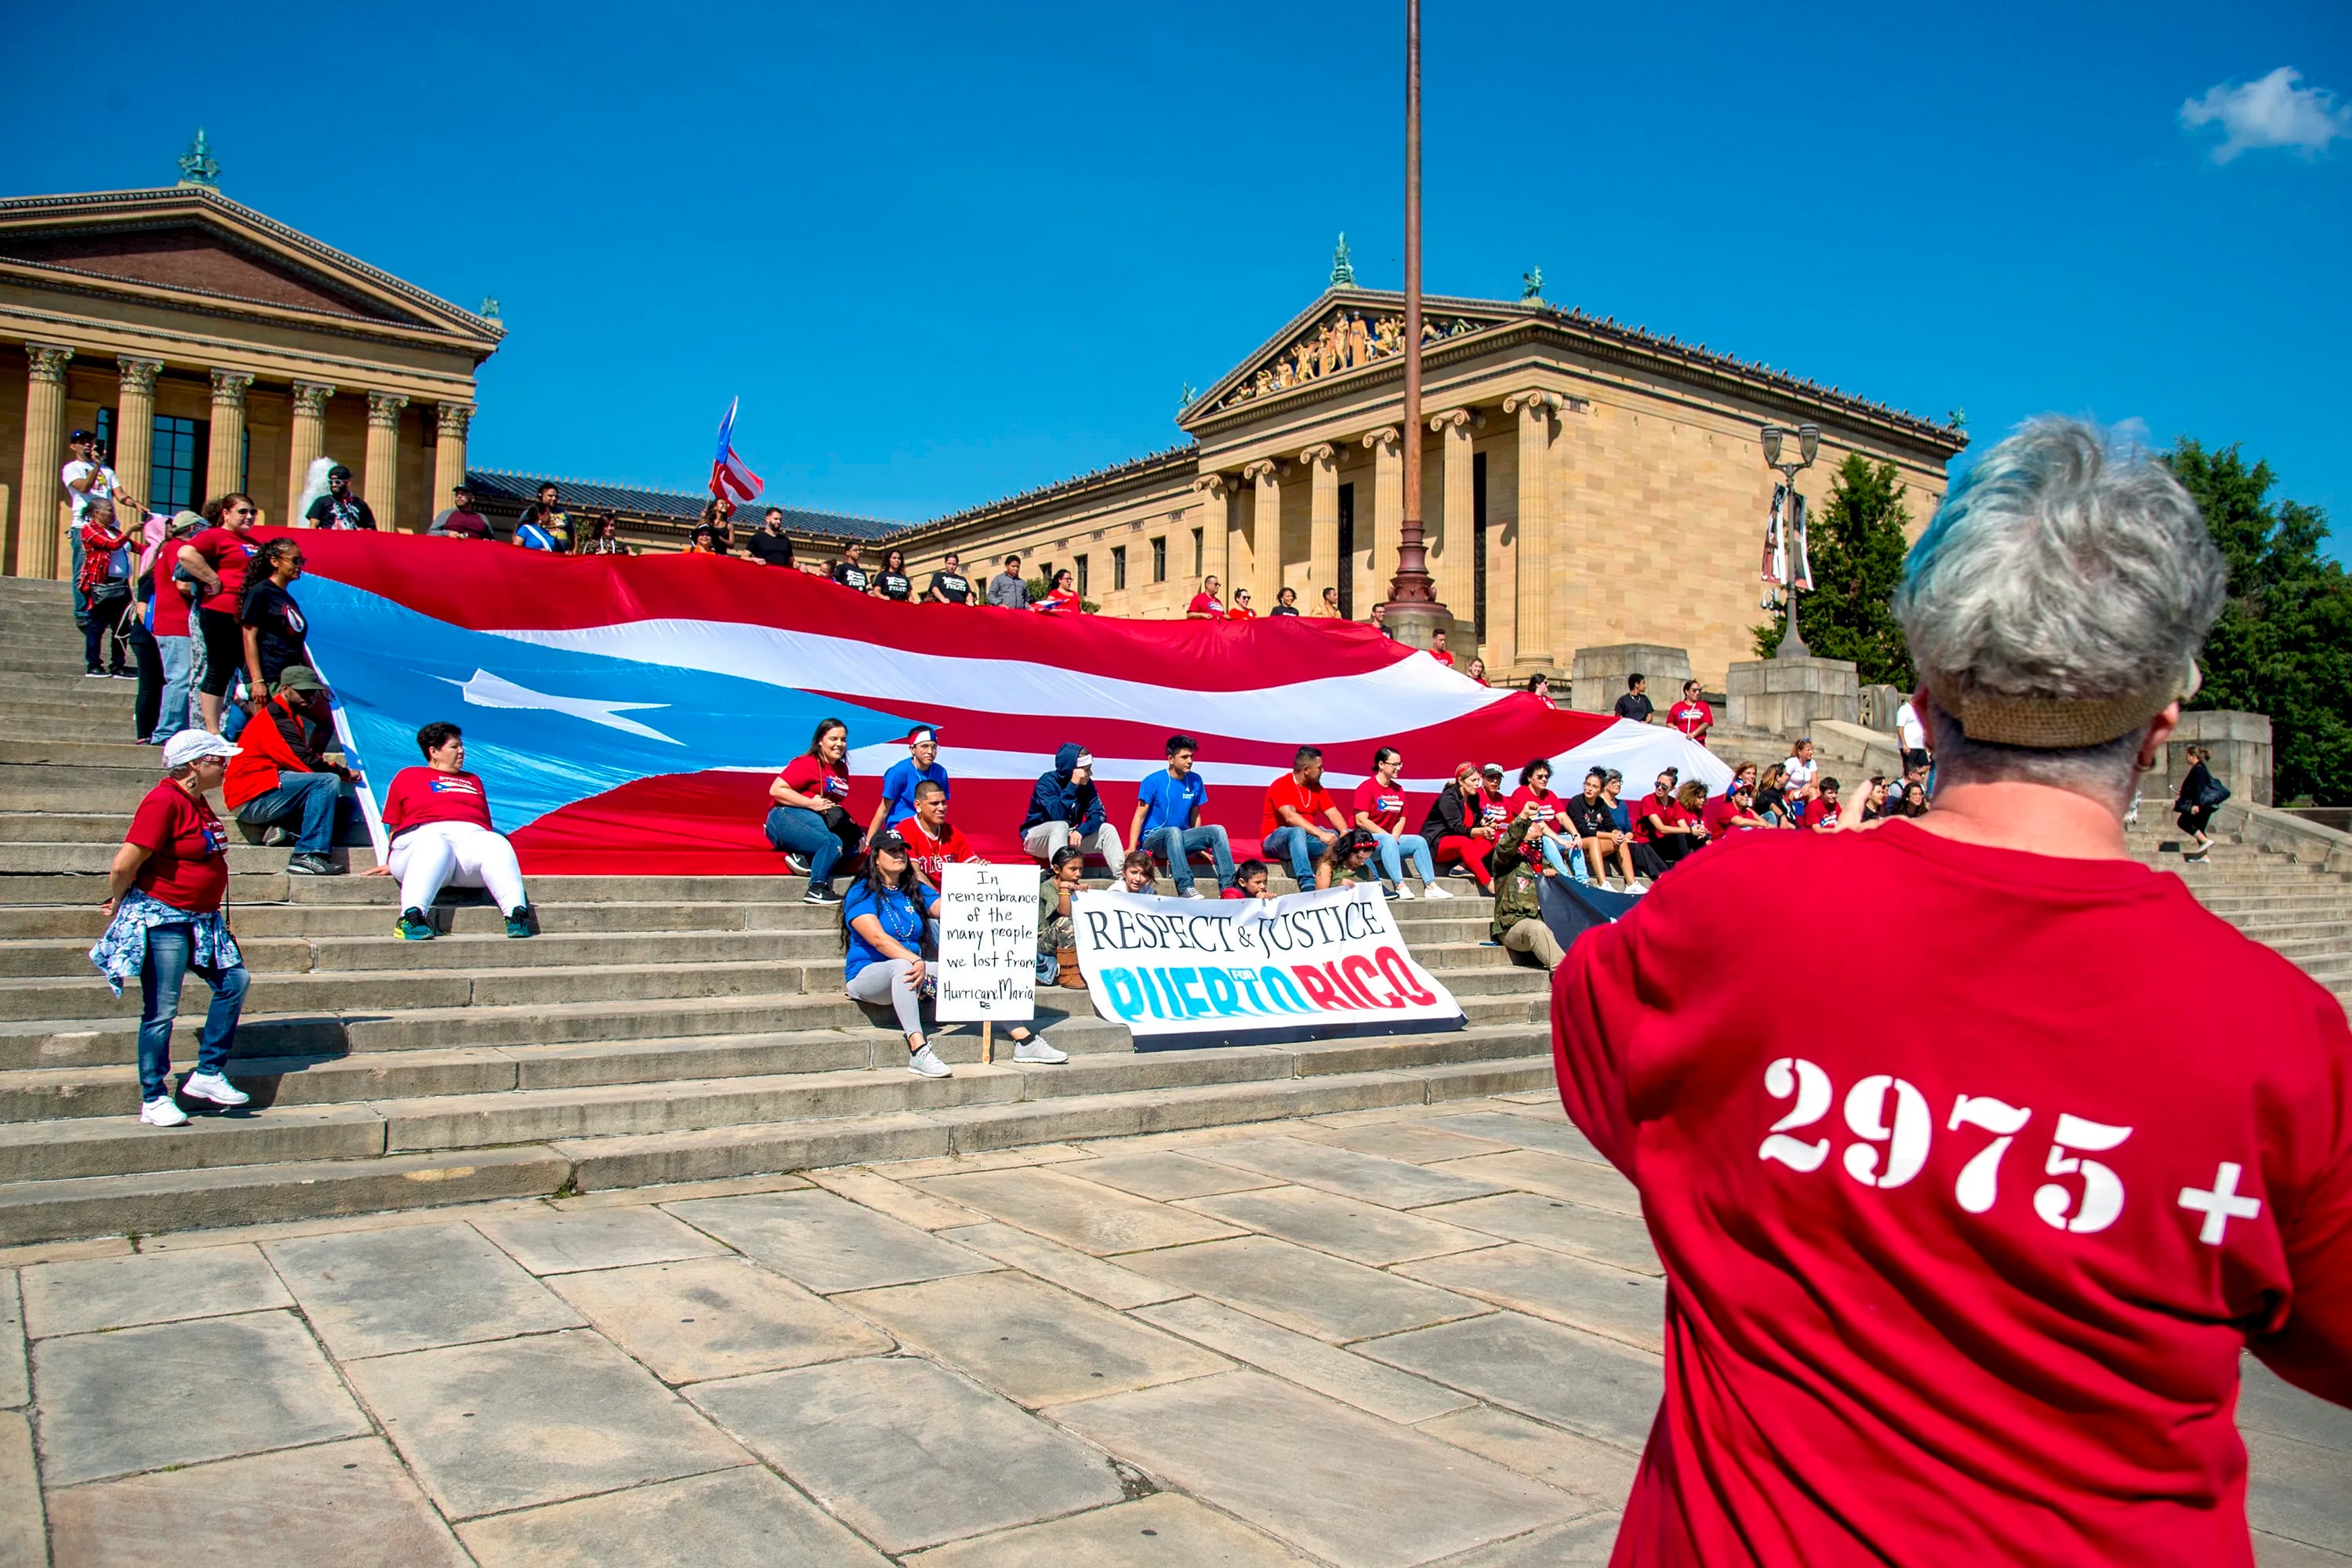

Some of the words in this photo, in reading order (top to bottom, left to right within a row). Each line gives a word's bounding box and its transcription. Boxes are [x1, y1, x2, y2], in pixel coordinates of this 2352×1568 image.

[977, 871, 999, 885] In
[947, 888, 1038, 904] remembrance
[967, 907, 980, 922] of
[988, 907, 1013, 923] the
[947, 928, 984, 951] many
[991, 924, 1034, 946] people
[1084, 909, 1235, 953] RESPECT
[1237, 926, 1255, 948] &
[1258, 901, 1385, 959] JUSTICE
[946, 957, 967, 968] we
[973, 950, 1000, 967] lost
[1004, 949, 1036, 968] from
[1099, 965, 1312, 1022] PUERTO
[1291, 946, 1437, 1011] RICO
[1231, 969, 1255, 981] FOR
[943, 981, 999, 1001] Hurricane
[999, 977, 1034, 1001] Maria
[1759, 1058, 2133, 1234] 2975
